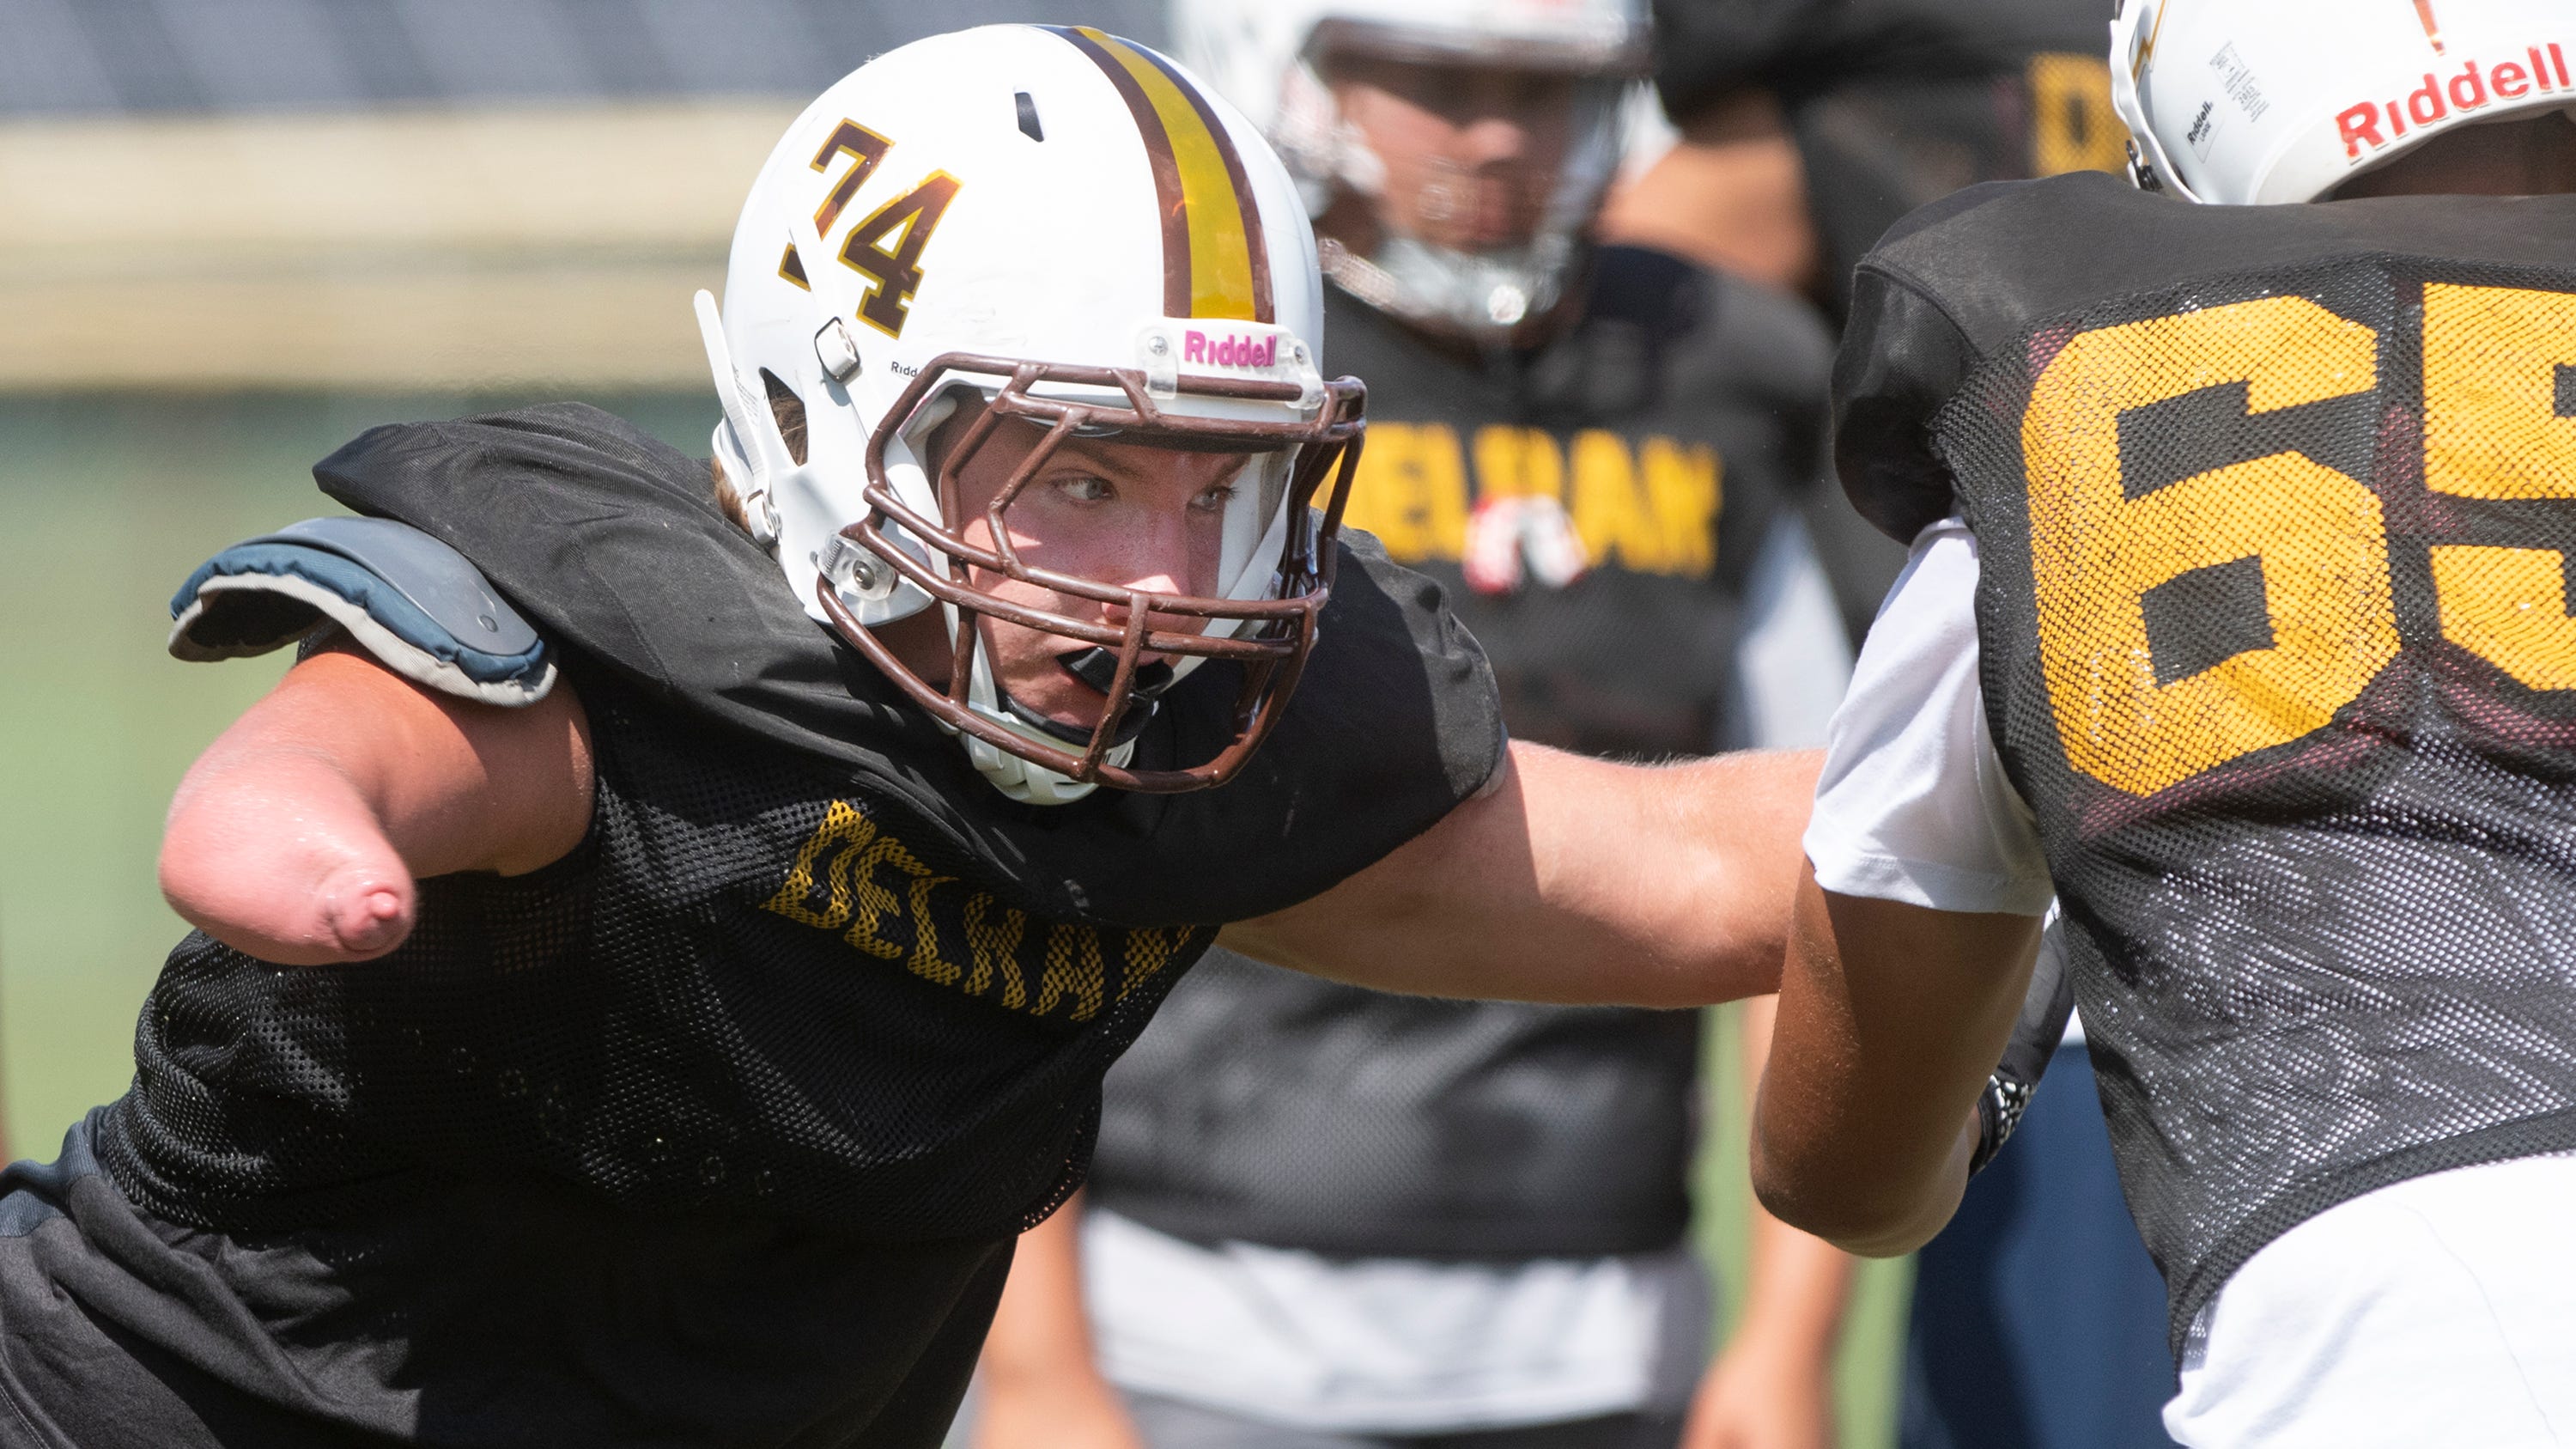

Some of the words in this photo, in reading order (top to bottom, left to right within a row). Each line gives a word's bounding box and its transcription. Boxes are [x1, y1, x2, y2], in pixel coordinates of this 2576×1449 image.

[2187, 100, 2213, 146] Riddell
[2334, 42, 2571, 159] Riddell
[778, 118, 964, 340] 74
[890, 361, 918, 377] Ridd
[1184, 330, 1277, 368] Riddell
